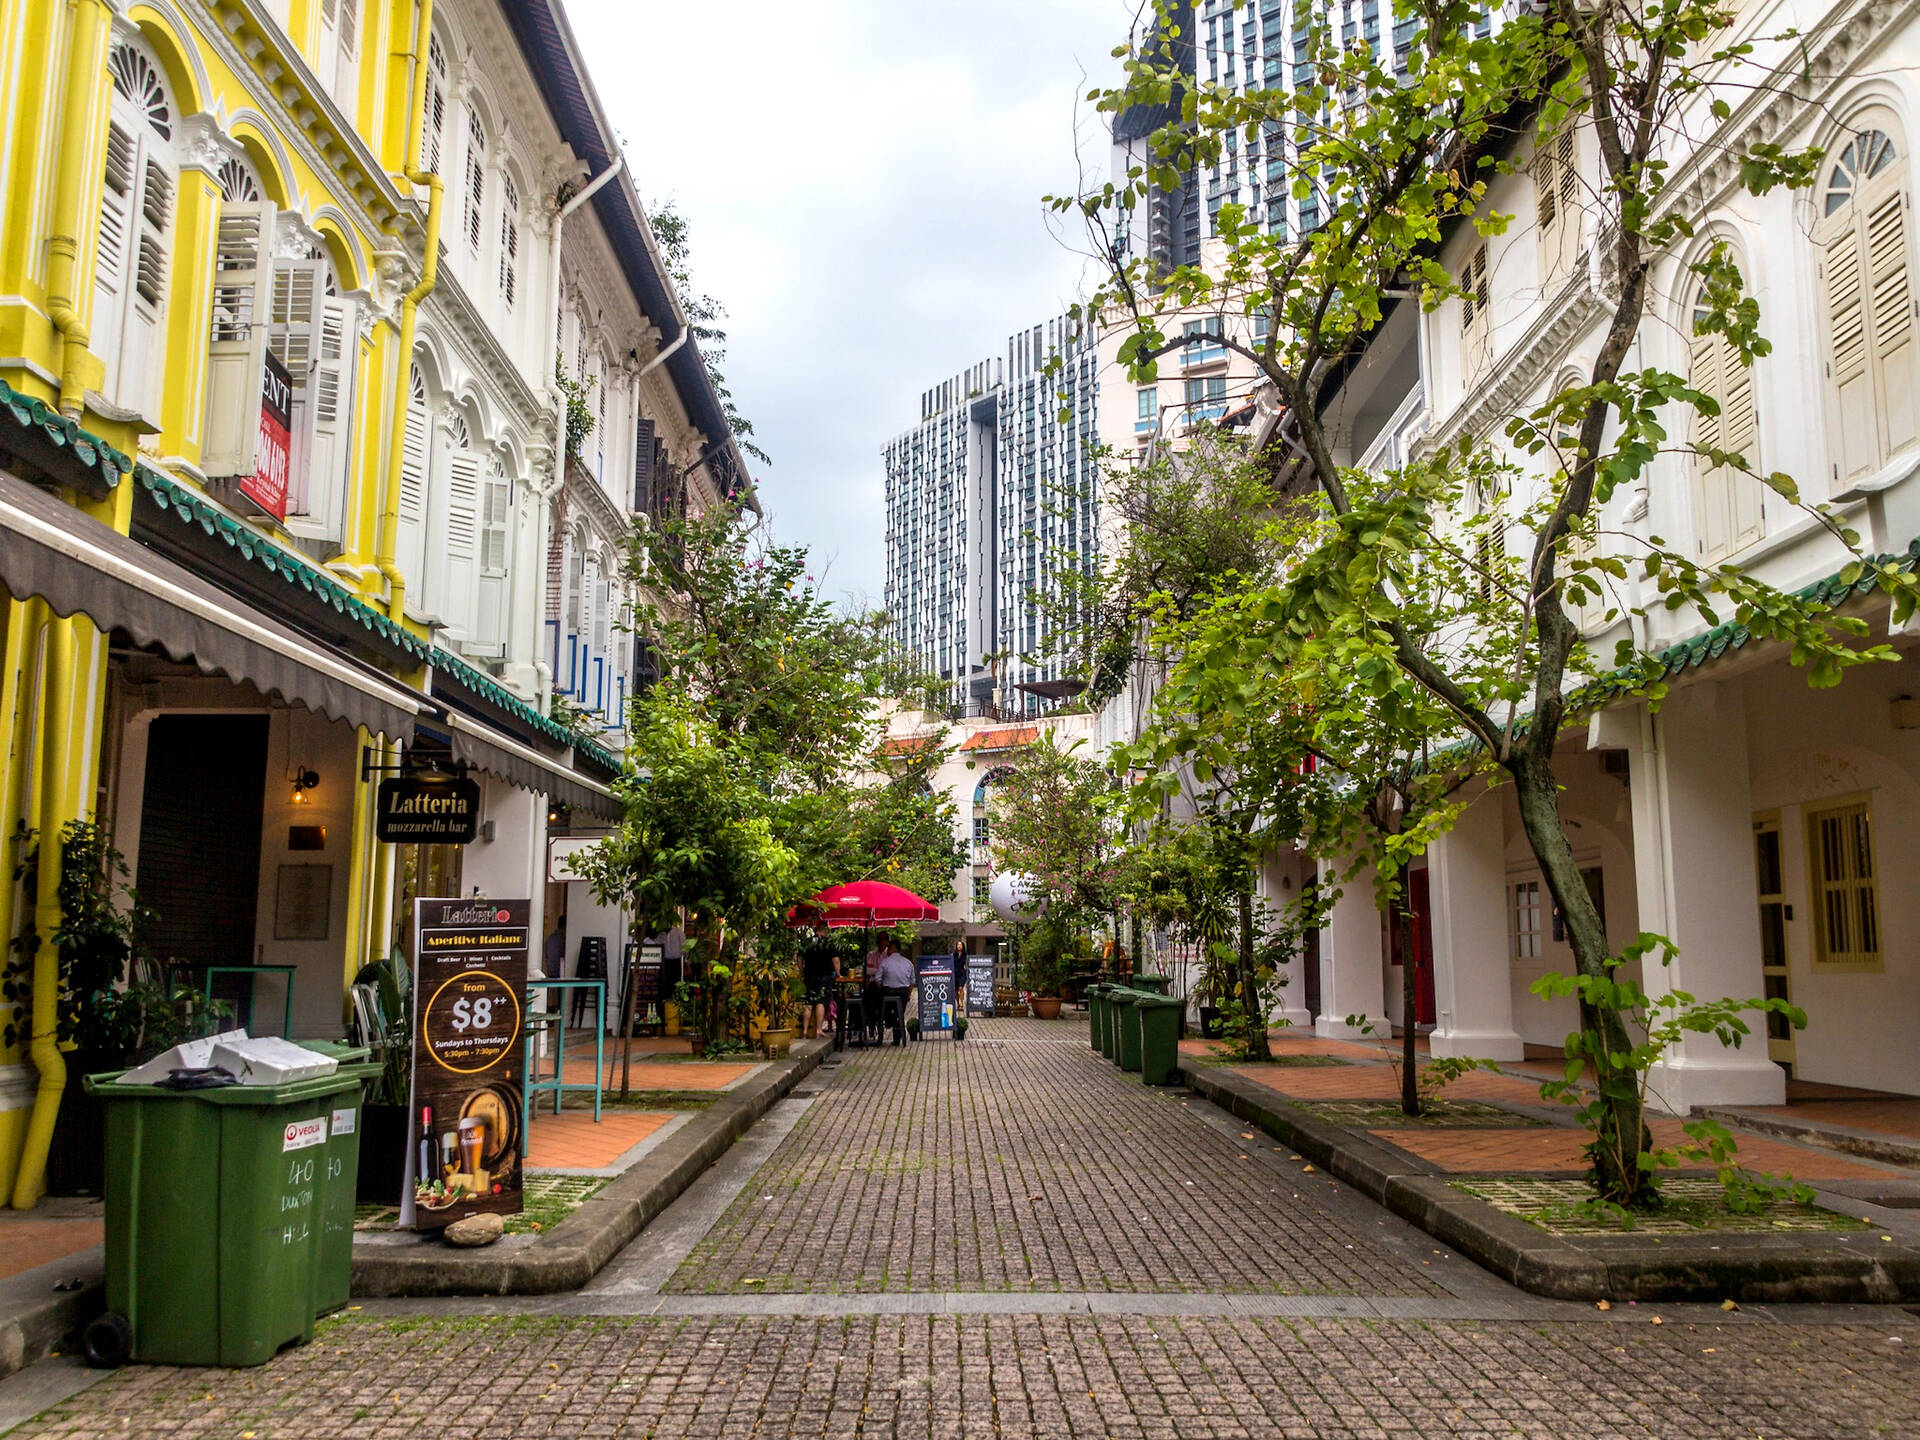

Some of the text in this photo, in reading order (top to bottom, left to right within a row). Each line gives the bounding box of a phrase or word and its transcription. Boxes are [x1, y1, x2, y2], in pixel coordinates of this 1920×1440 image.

[388, 791, 468, 814] Latteria
[387, 819, 468, 833] mozzarella bar
[427, 934, 523, 946] Aperitivo Italiano
[463, 983, 486, 992] from
[435, 1040, 464, 1049] Sundays
[474, 1036, 509, 1045] Thursdays
[444, 1050, 470, 1058] 5:30pm
[475, 1047, 500, 1056] 7:30pm
